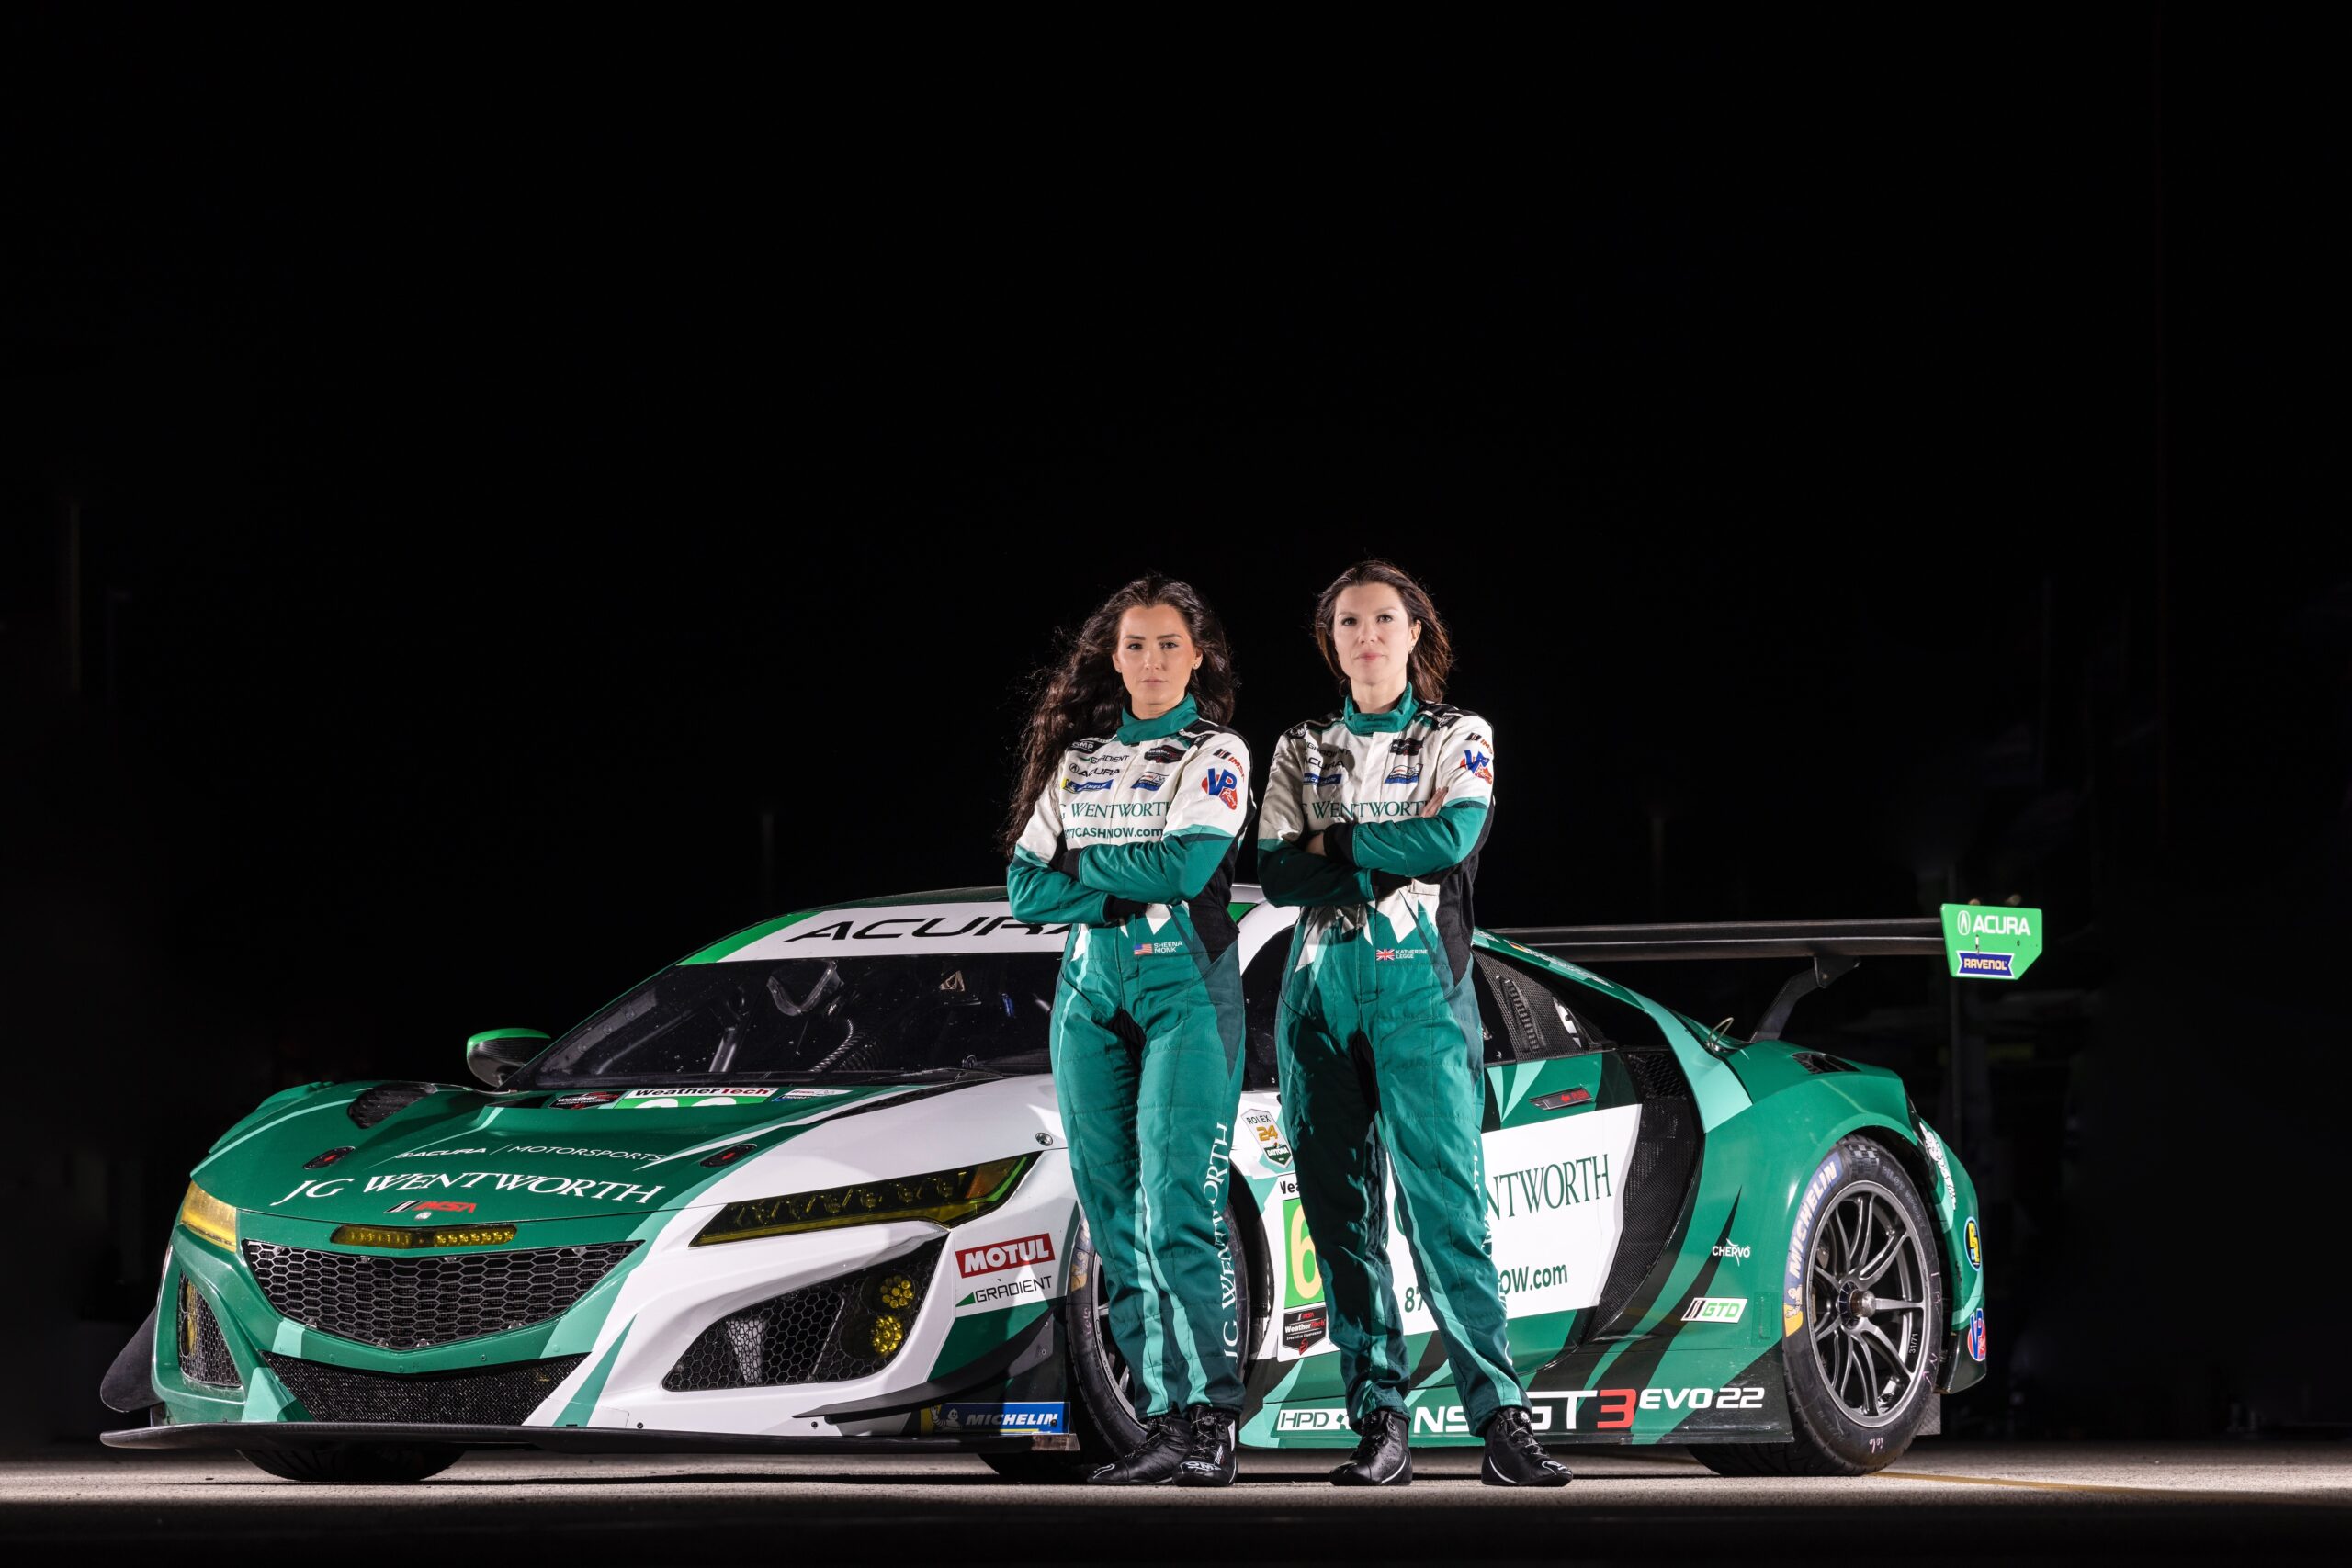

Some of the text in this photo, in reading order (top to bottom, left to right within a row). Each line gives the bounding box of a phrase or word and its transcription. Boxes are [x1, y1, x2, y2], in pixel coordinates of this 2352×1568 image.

[1312, 800, 1426, 819] WENTWORT
[781, 917, 1071, 942] ACUR
[1973, 915, 2031, 935] ACURA
[1154, 941, 1183, 949] SHEENA
[1963, 958, 2007, 971] RAVENOL
[1246, 1114, 1272, 1125] ROLEX
[1256, 1125, 1279, 1142] 24
[412, 1145, 666, 1162] ACURA MOTORSPORTS
[269, 1173, 666, 1206] JG WENTWORTH
[1487, 1154, 1612, 1220] NTWORTH
[1788, 1160, 1838, 1279] MICHELIN
[964, 1238, 1050, 1275] MOTUL
[1291, 1204, 1322, 1300] 6
[975, 1276, 1052, 1303] GRADIENT
[1702, 1303, 1741, 1318] GTD
[1284, 1319, 1325, 1333] WeatherTech
[1908, 1332, 1918, 1354] 31/71
[966, 1413, 1058, 1427] MICHELIN
[1280, 1412, 1329, 1428] HPD
[1413, 1405, 1470, 1434] NS
